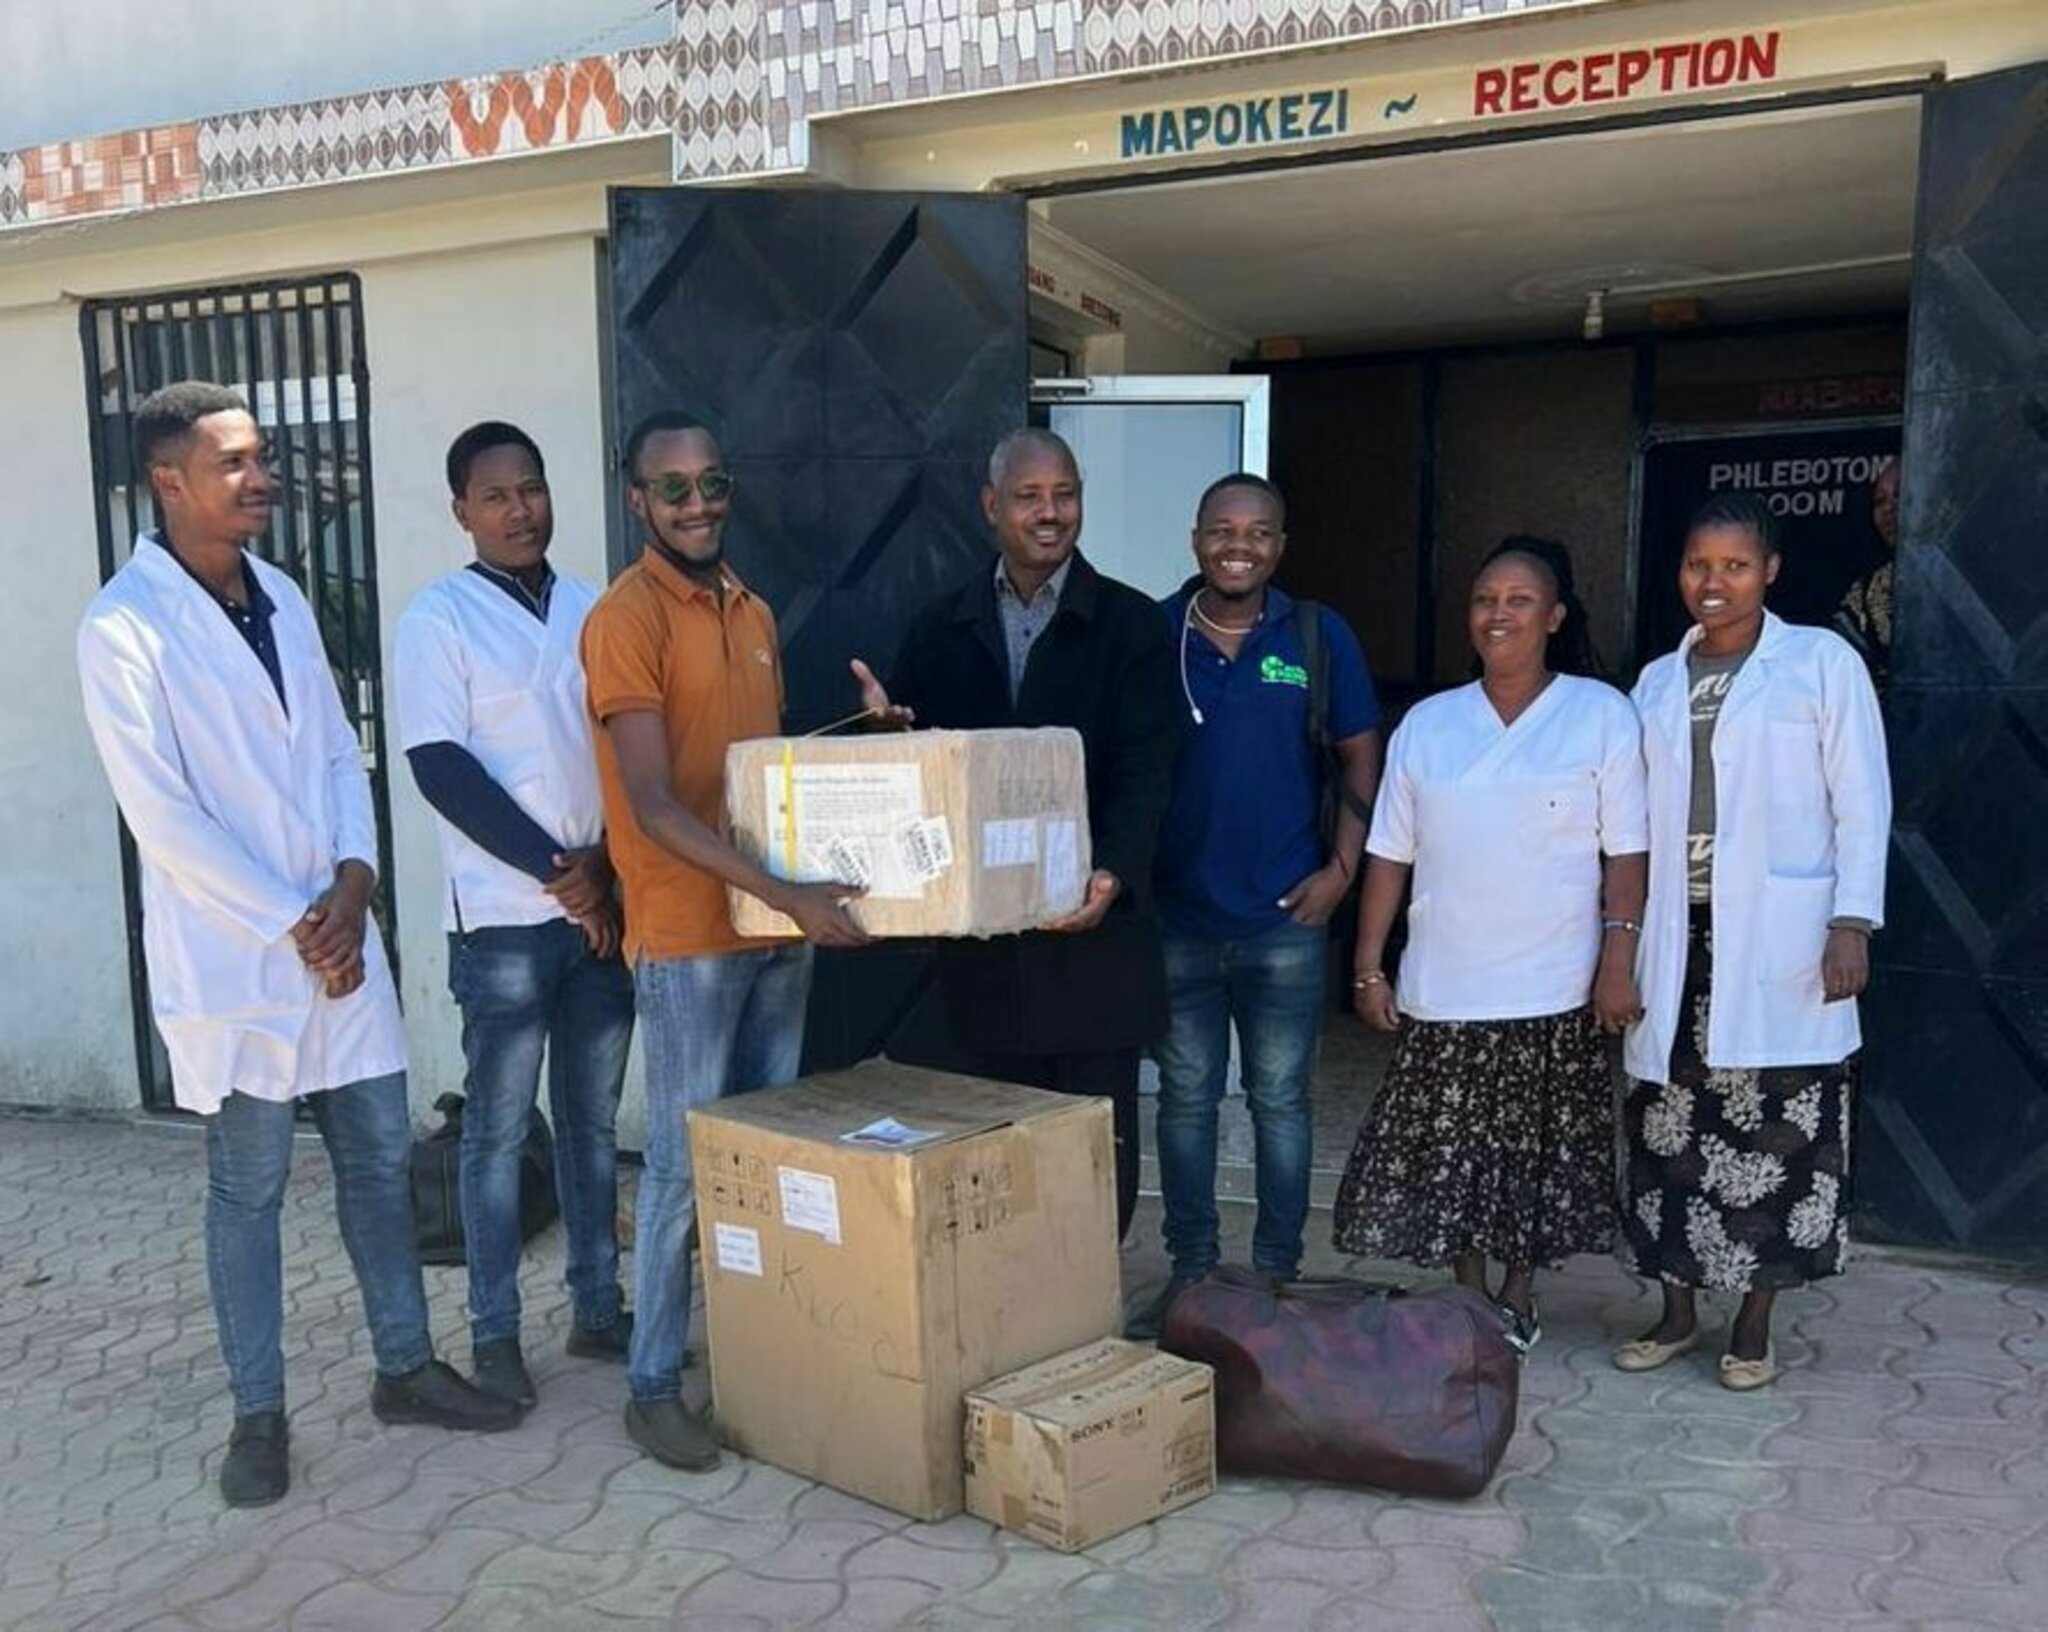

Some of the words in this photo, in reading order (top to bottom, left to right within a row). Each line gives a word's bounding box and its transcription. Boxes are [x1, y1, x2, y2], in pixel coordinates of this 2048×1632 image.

[1121, 88, 1348, 157] MAPOKEZI
[1474, 31, 1780, 116] RECEPTION
[1709, 453, 1898, 491] PHLEBOTOM
[1757, 489, 1845, 517] OOM
[1071, 1418, 1115, 1443] SONY
